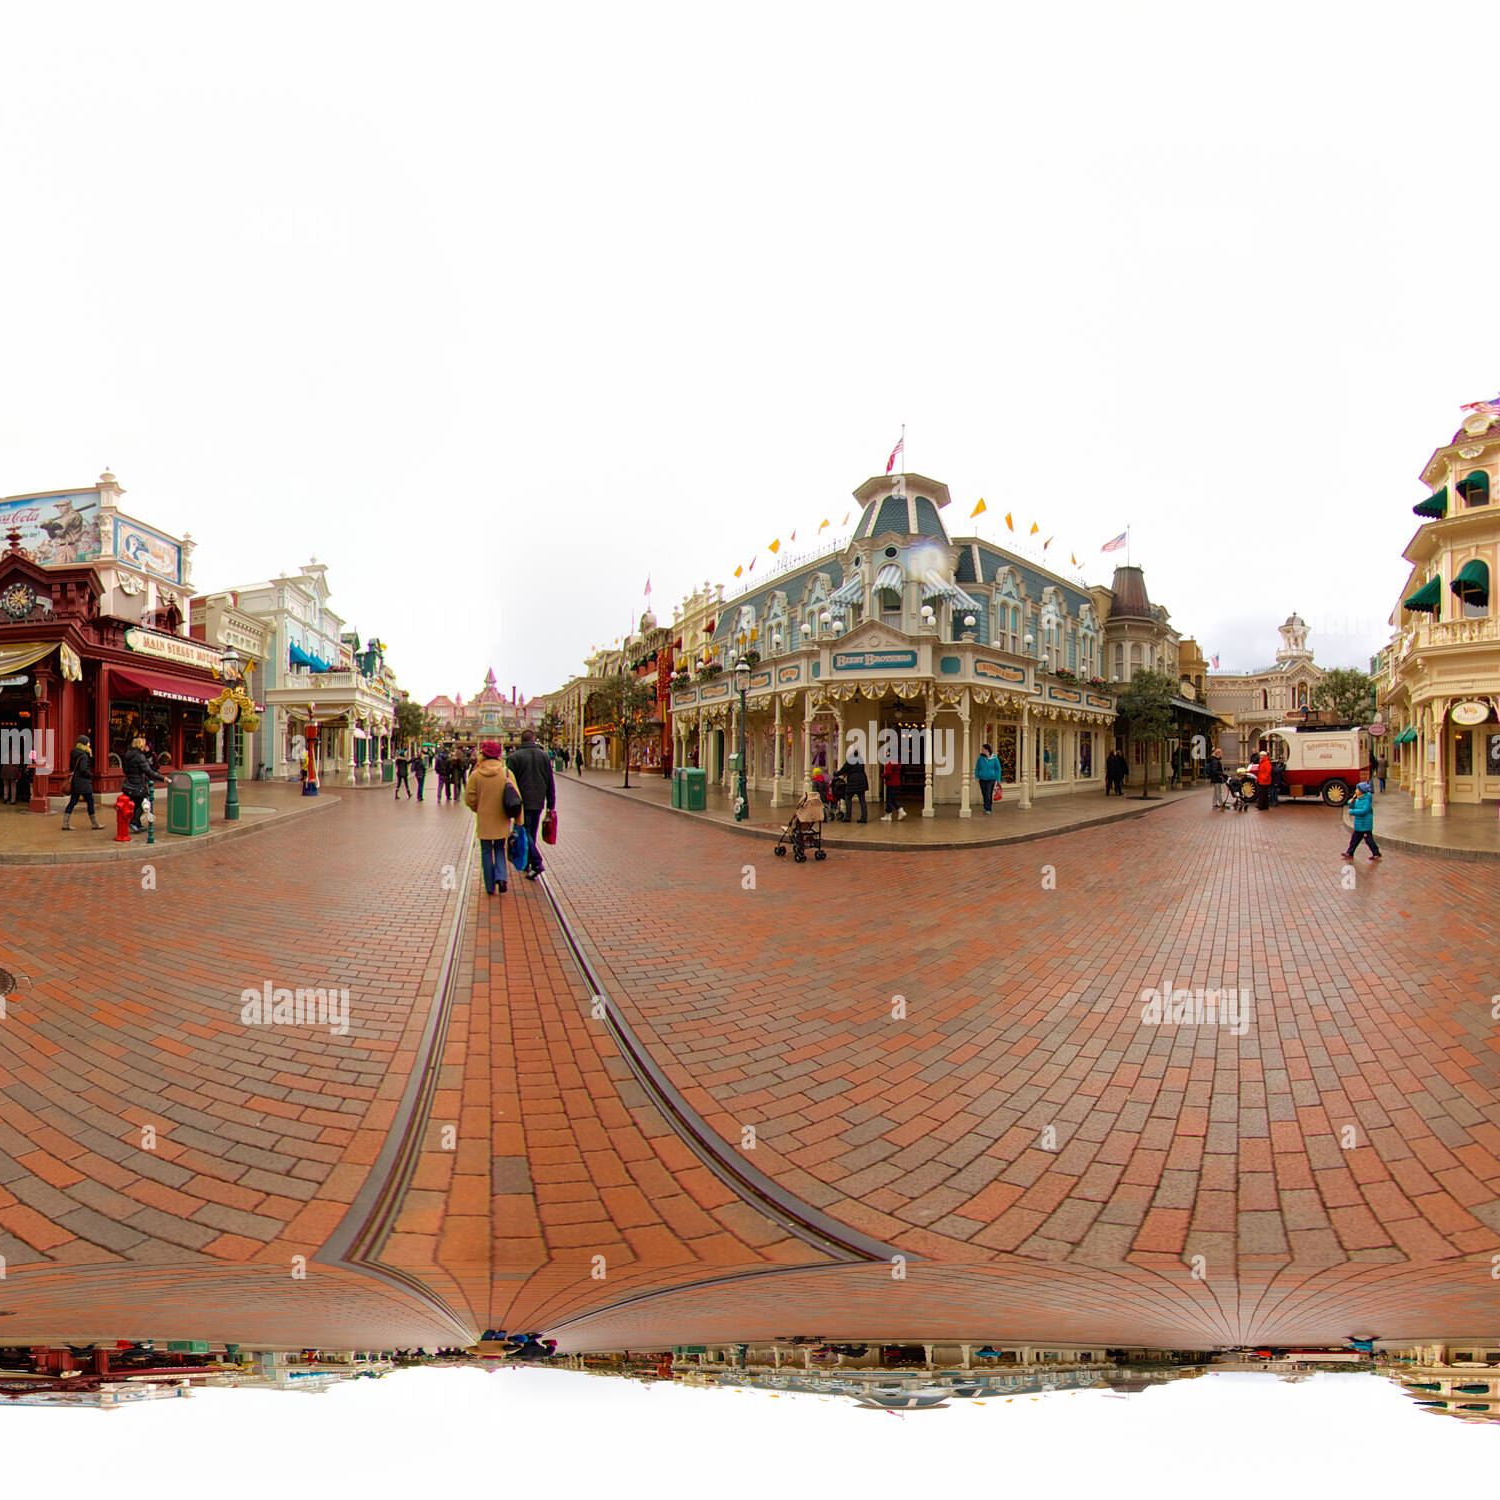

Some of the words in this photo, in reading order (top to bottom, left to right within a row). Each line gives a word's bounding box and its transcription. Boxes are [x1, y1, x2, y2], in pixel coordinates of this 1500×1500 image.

[143, 636, 165, 652] MAIN
[167, 642, 194, 659] STREET
[152, 689, 200, 704] DEPENDABLE
[223, 707, 234, 715] 20
